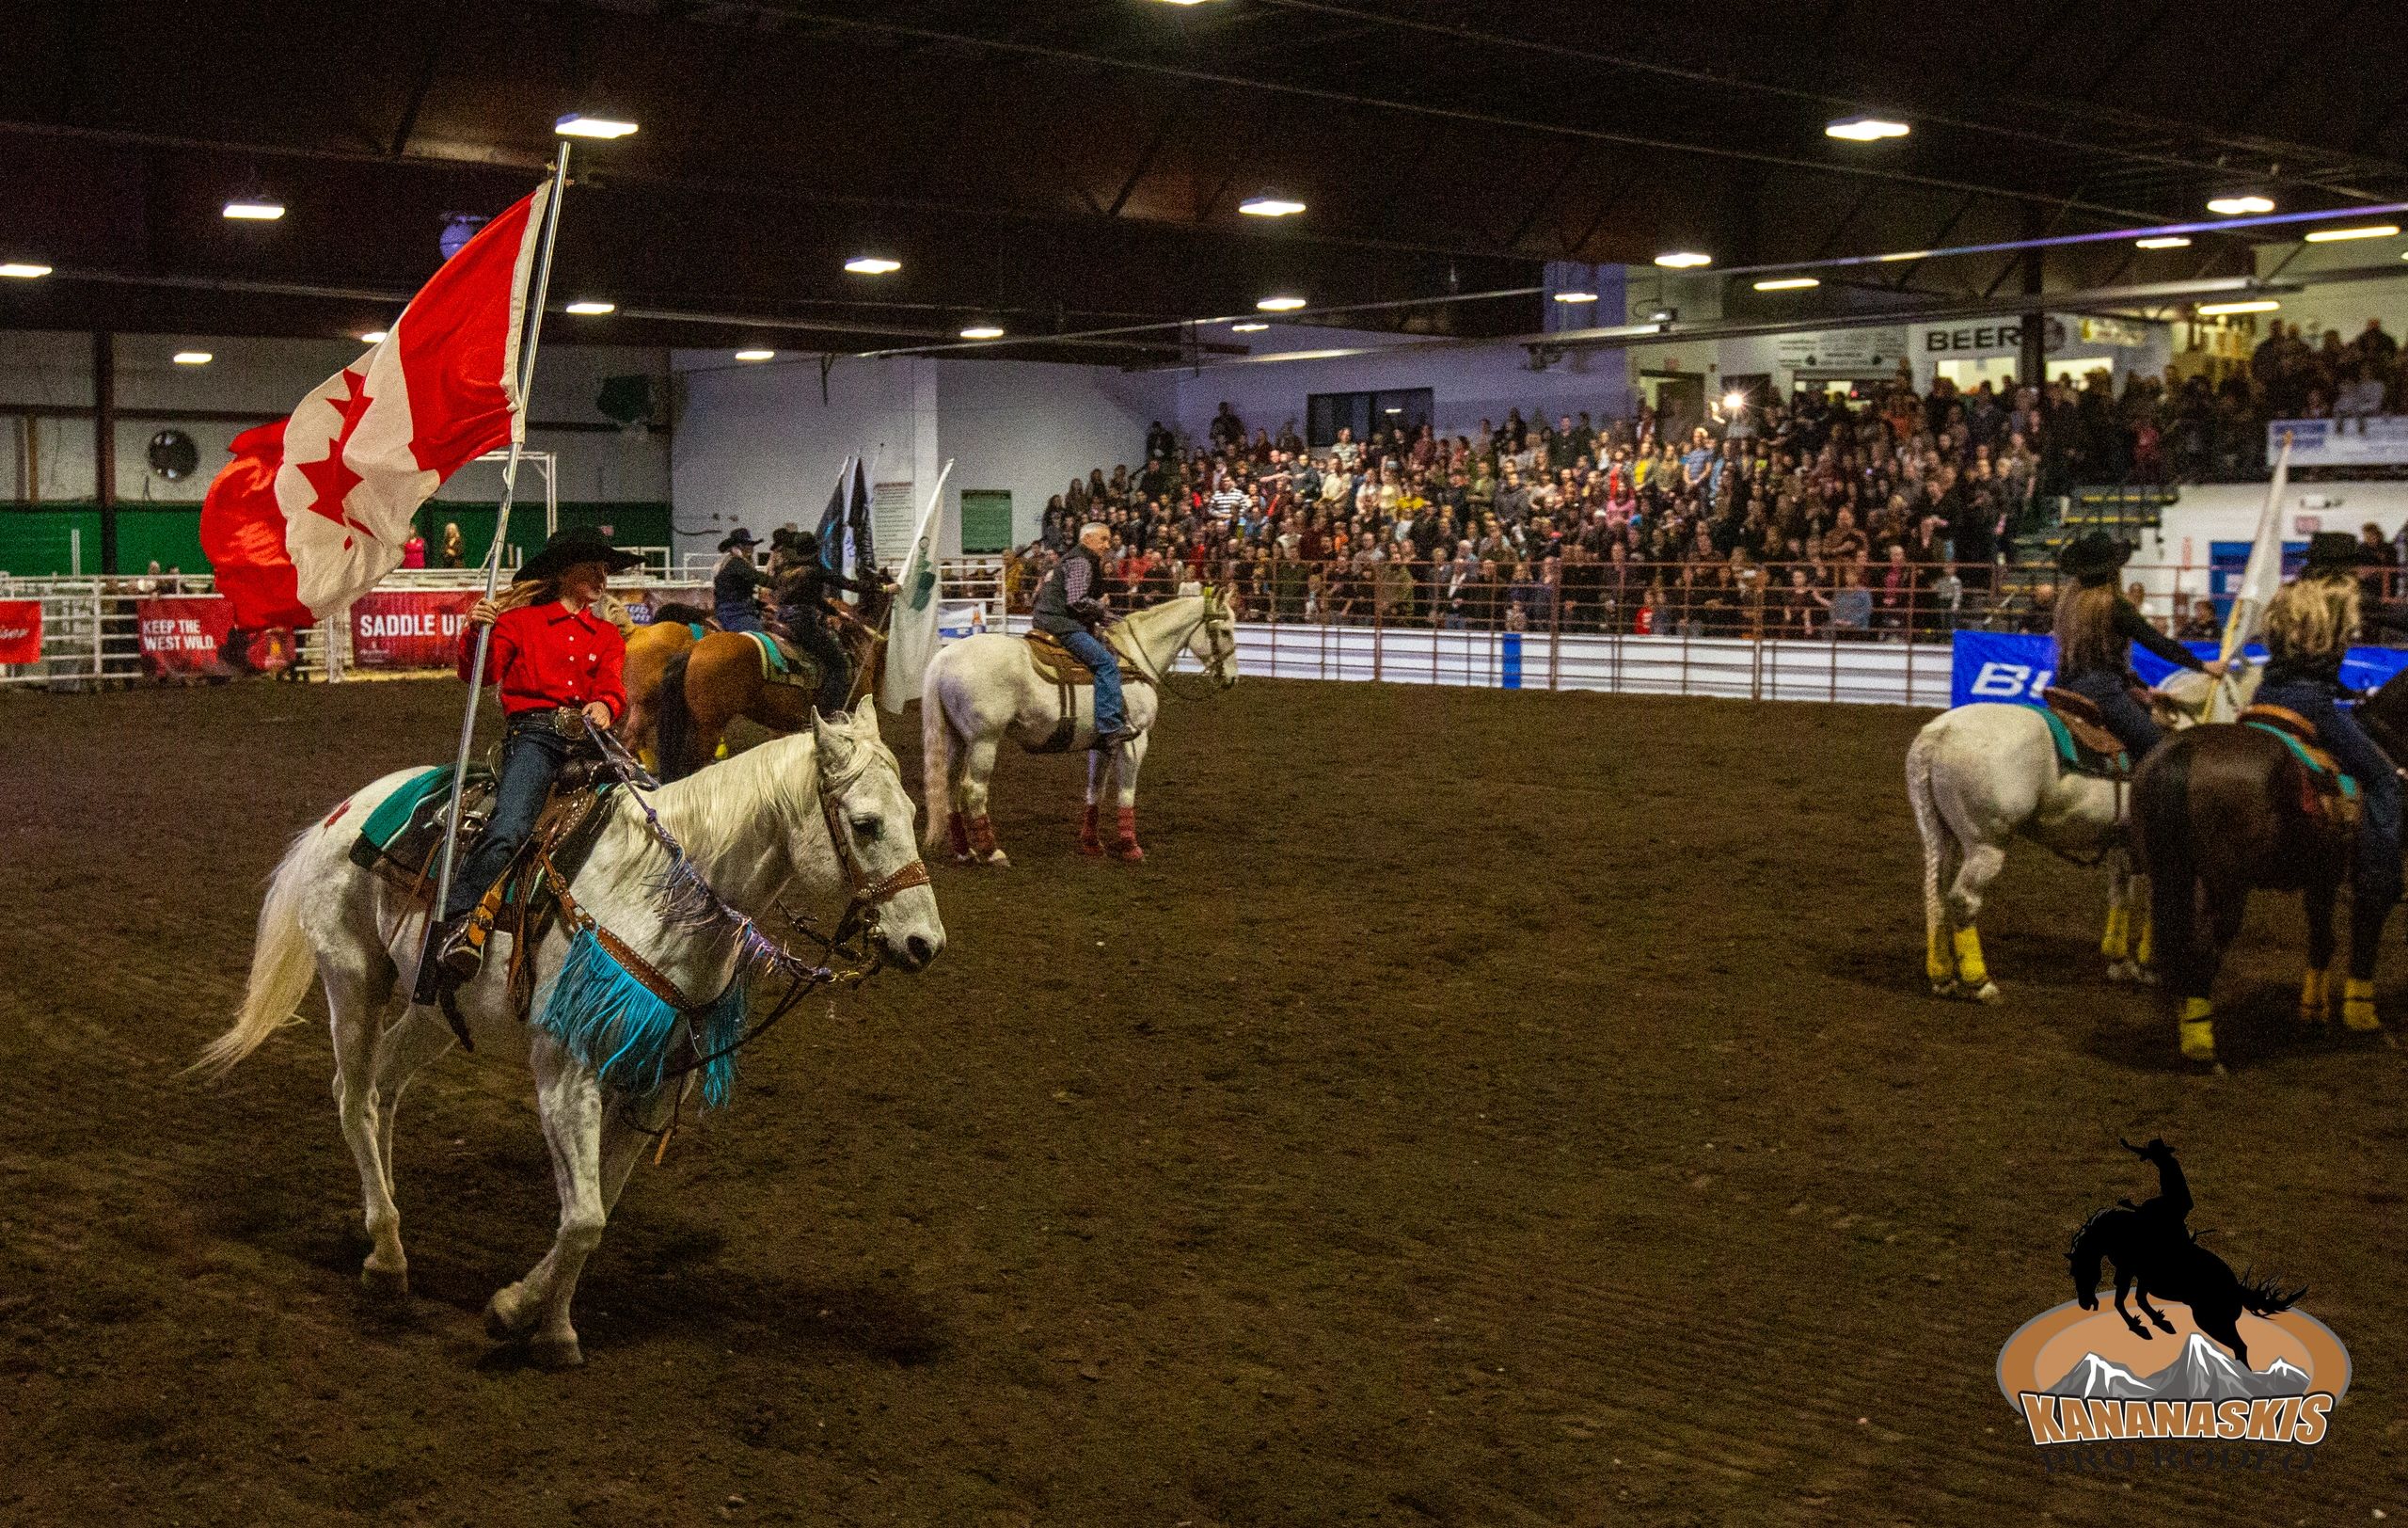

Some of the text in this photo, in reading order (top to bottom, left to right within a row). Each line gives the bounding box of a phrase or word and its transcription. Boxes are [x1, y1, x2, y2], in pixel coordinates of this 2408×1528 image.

[1926, 326, 2021, 351] BEER
[143, 619, 200, 634] KEEP THE
[360, 613, 436, 637] SADDLE
[144, 636, 181, 651] WEST
